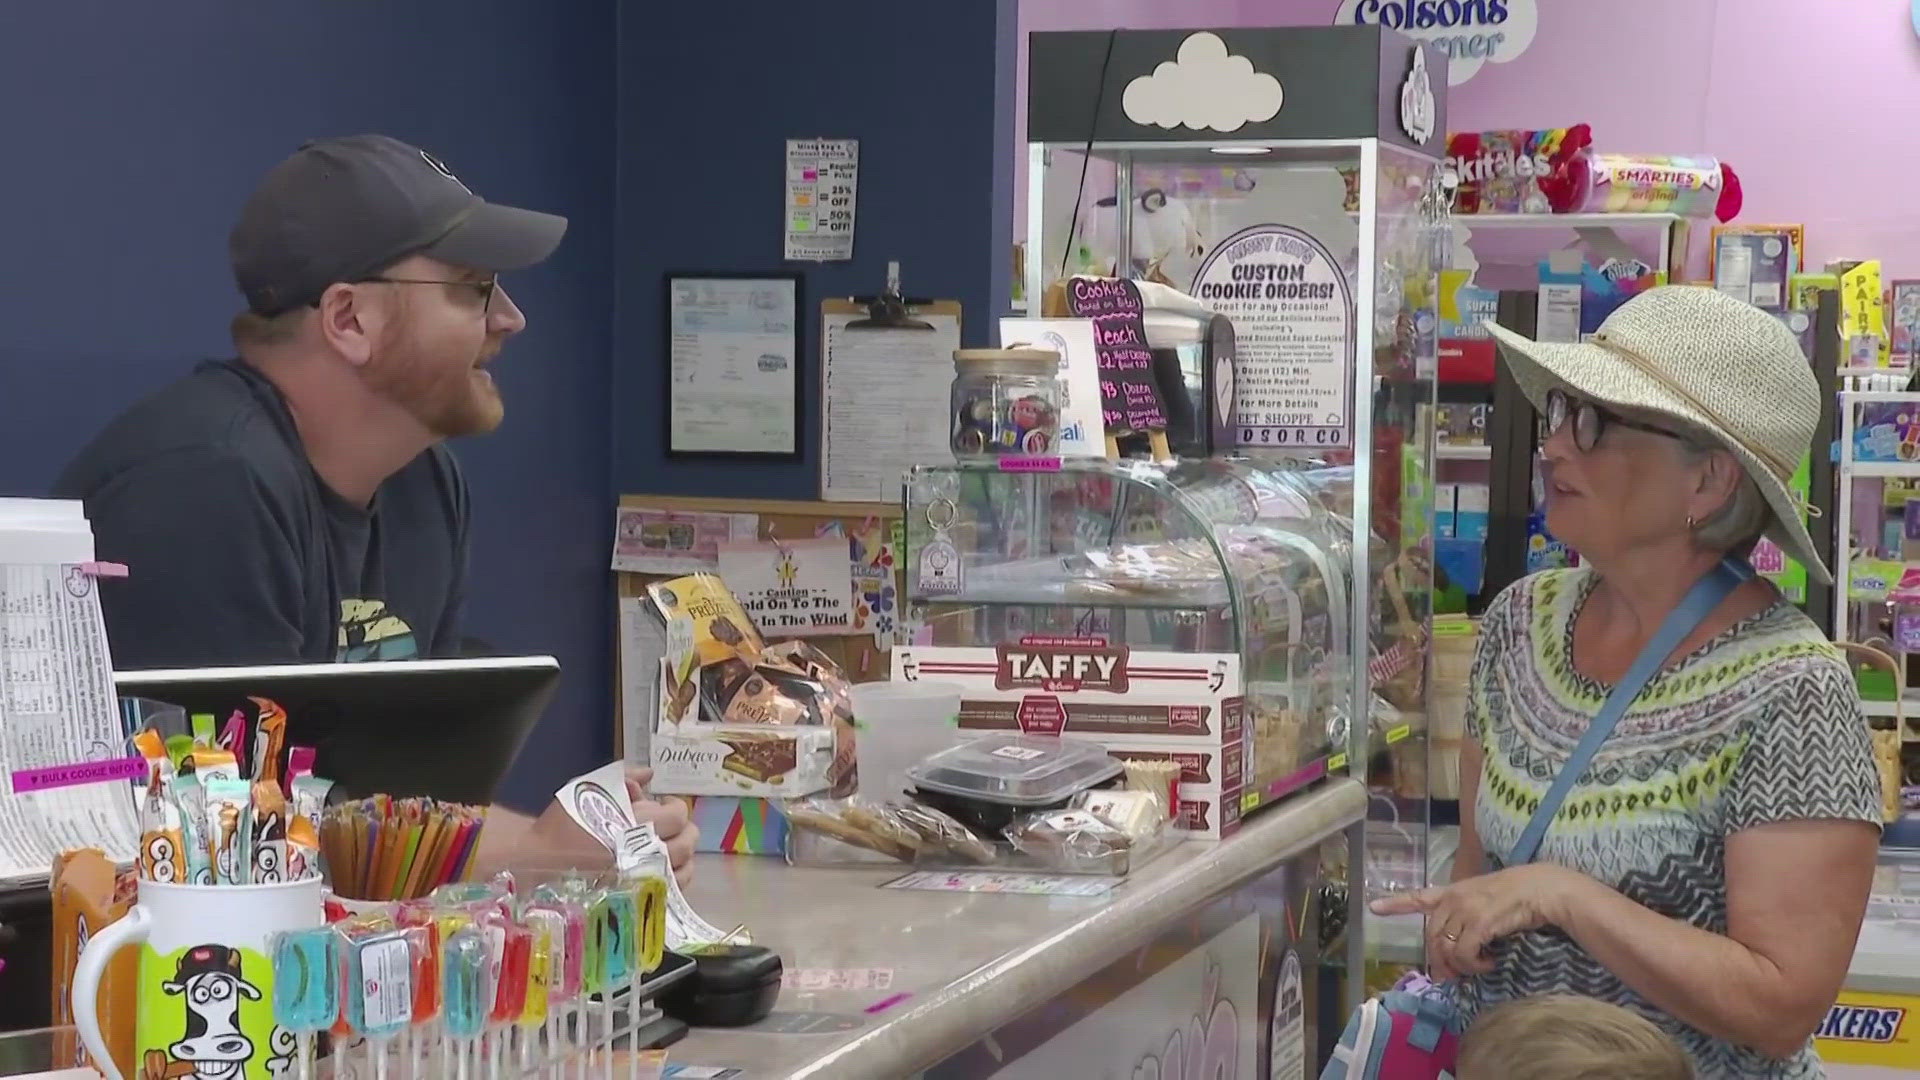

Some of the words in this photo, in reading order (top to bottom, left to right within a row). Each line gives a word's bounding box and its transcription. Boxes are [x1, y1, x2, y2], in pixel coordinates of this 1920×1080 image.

[1355, 0, 1509, 29] Colsons
[830, 163, 856, 172] Regular
[1615, 168, 1696, 186] SMARTIES
[832, 186, 851, 195] 25%
[1632, 187, 1679, 202] original
[831, 198, 848, 206] OFF
[830, 211, 851, 220] 50%
[1226, 236, 1273, 265] MISSY
[1231, 264, 1305, 282] CUSTOM
[1074, 282, 1127, 301] Cookies
[1202, 282, 1262, 300] COOKIE
[1265, 282, 1335, 300] ORDERS!
[1213, 302, 1239, 312] Great
[1243, 302, 1257, 311] for
[1260, 303, 1277, 314] any
[1281, 302, 1329, 312] Occasion!
[1466, 299, 1497, 312] SUPER
[1104, 326, 1140, 346] each
[1242, 367, 1269, 376] Dozen
[1272, 367, 1289, 376] (12)
[1293, 367, 1312, 376] Min.
[1122, 382, 1151, 395] Dozen
[1274, 378, 1309, 387] Required
[1240, 399, 1255, 408] for
[1258, 399, 1281, 408] More
[1285, 399, 1319, 408] Details
[1238, 413, 1258, 425] EET
[1264, 413, 1313, 425] SHOPPE
[766, 587, 809, 599] Caution
[768, 598, 788, 611] On
[791, 598, 809, 611] To
[812, 597, 839, 610] The
[761, 614, 776, 627] In
[779, 613, 807, 626] The
[810, 612, 848, 627] Wind
[1006, 653, 1118, 681] TAFFY
[41, 772, 69, 784] BULK
[70, 767, 105, 781] COOKIE
